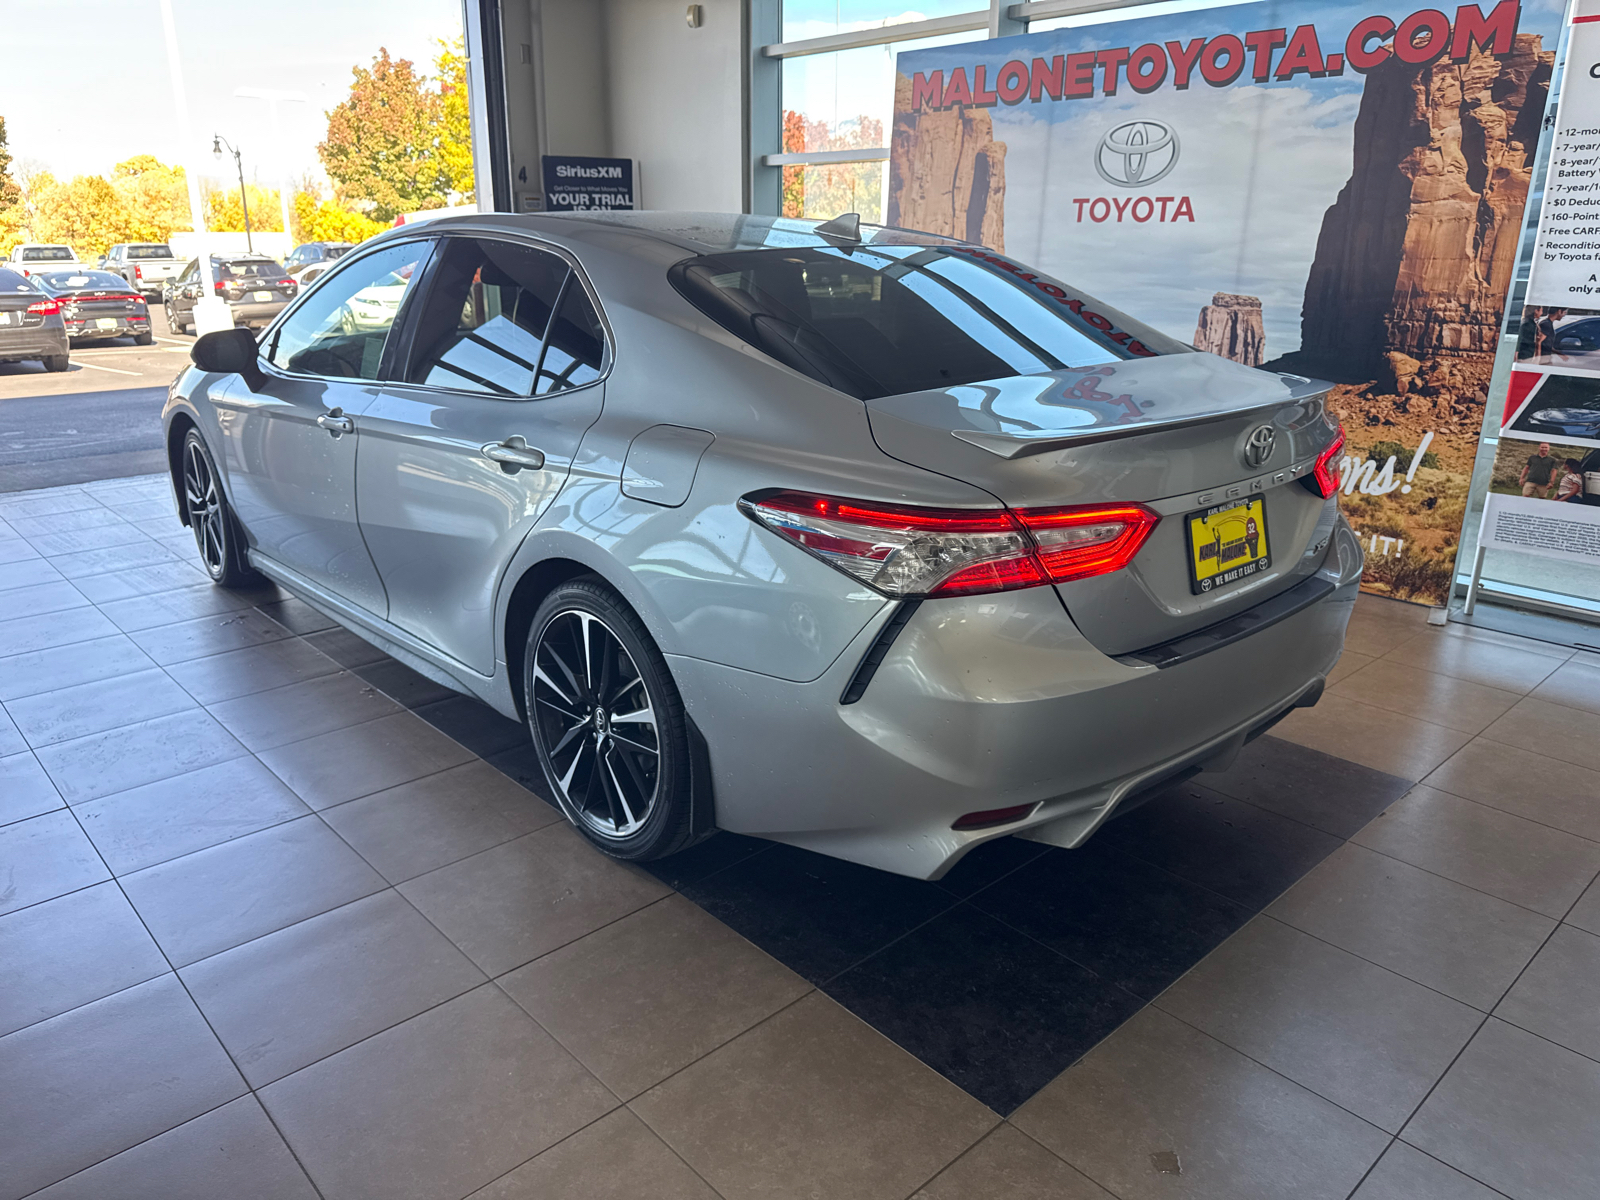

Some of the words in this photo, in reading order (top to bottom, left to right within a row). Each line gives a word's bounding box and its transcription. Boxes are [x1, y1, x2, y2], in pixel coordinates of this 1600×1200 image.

[911, 0, 1522, 113] MALONETOYOTA.COM
[1565, 128, 1600, 136] 12-mo
[518, 166, 527, 183] 4
[556, 165, 622, 178] SiriusXM
[1558, 169, 1596, 178] Battery
[549, 193, 589, 205] YOUR
[592, 194, 633, 206] TRIAL
[1553, 198, 1566, 207] $0
[1072, 197, 1195, 223] TOYOTA
[1551, 212, 1599, 221] 160-Point
[1548, 227, 1570, 235] Free
[1572, 226, 1600, 235] CARF
[1544, 252, 1557, 261] by
[1558, 252, 1592, 262] Toyota
[1588, 273, 1597, 282] A
[1568, 284, 1593, 295] only
[1247, 522, 1256, 534] 32
[1369, 534, 1404, 558] IT!
[1215, 575, 1223, 586] WE
[1224, 569, 1238, 583] MAKE
[1238, 568, 1243, 578] IT
[1244, 563, 1257, 576] EASY
